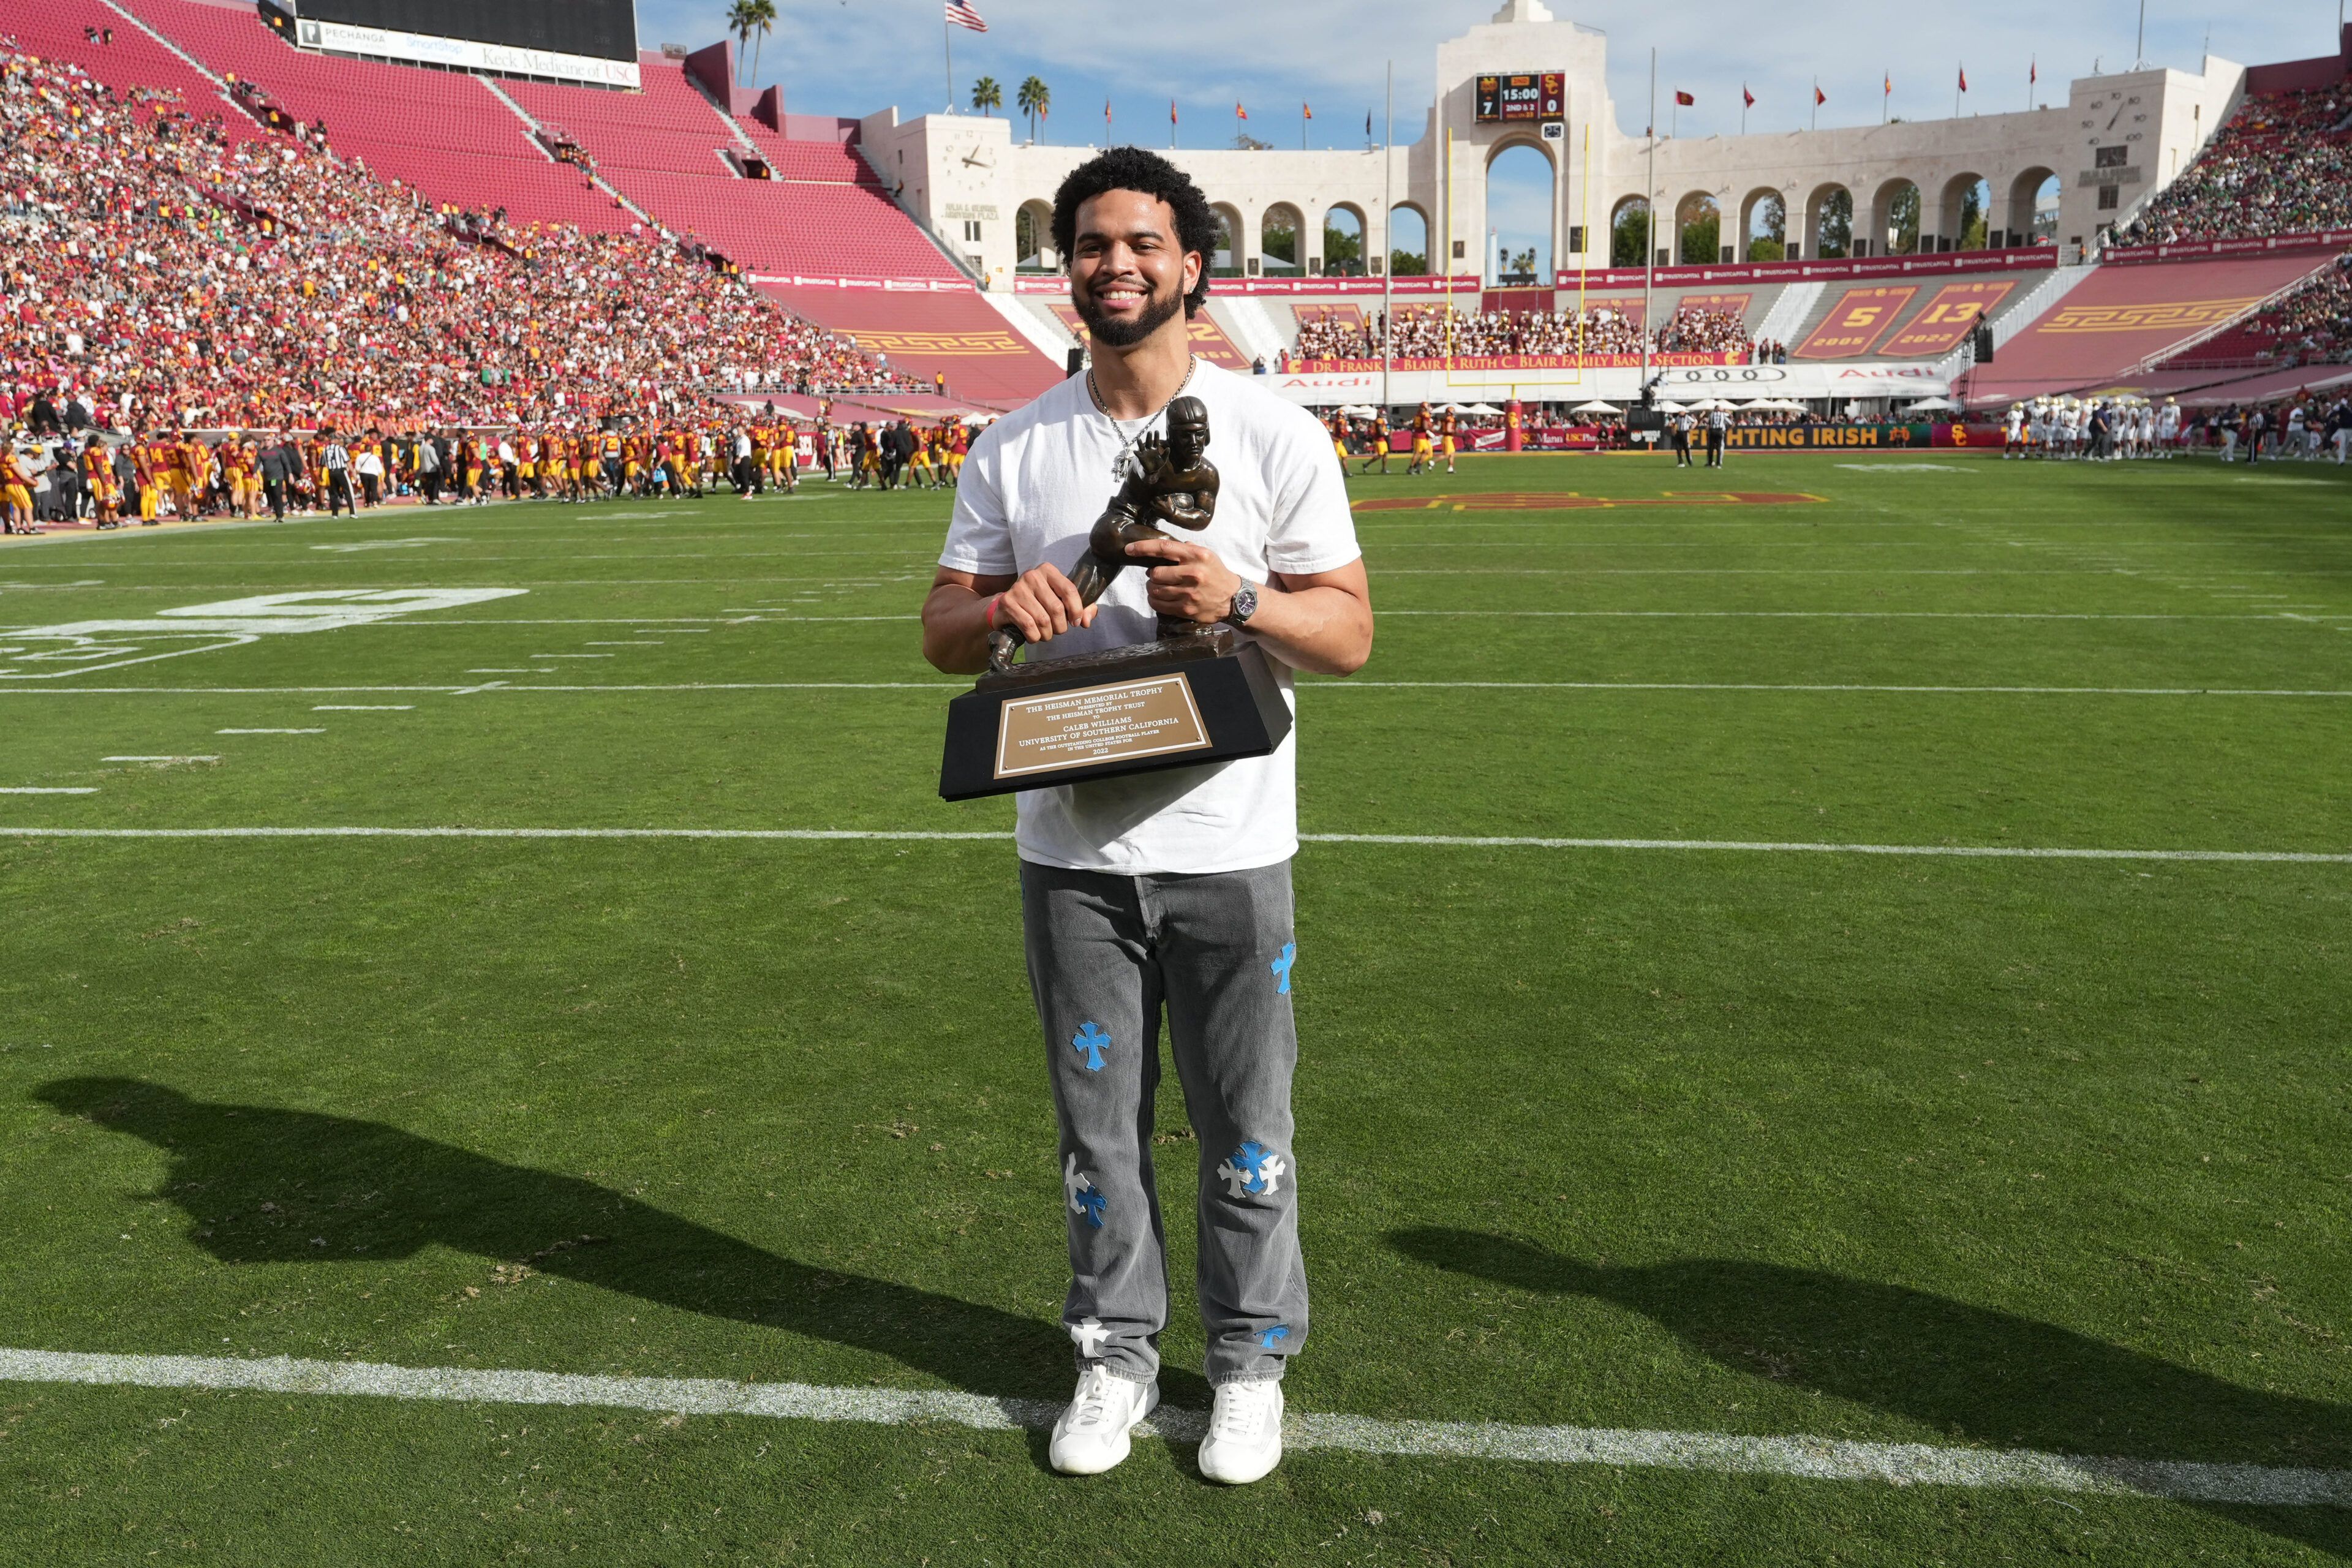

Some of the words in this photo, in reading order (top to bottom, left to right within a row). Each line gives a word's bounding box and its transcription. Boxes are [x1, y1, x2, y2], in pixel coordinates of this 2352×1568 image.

[325, 28, 385, 43] PECHANGA
[406, 37, 464, 54] SmartStop
[483, 48, 519, 68] Keck
[523, 53, 585, 77] Medicine
[587, 62, 602, 78] of
[605, 65, 636, 81] USC
[1503, 88, 1539, 100] 15:00
[1483, 102, 1493, 115] 7
[1547, 99, 1557, 112] 0
[1545, 126, 1561, 138] 25
[1842, 306, 1883, 328] 5
[1921, 302, 1983, 324] 13
[1186, 323, 1223, 341] 2
[1899, 333, 1953, 344] 2022
[1812, 337, 1865, 347] 2005
[1313, 361, 1335, 373] DR.
[1340, 360, 1384, 372] FRANK
[1404, 358, 1442, 371] BLAIR
[1460, 357, 1498, 369] RUTH
[1501, 356, 1515, 368] C.
[1520, 355, 1558, 368] BLAIR
[1562, 355, 1609, 367] FAMILY
[1655, 353, 1714, 366] SECTION
[1838, 366, 1935, 378] Audi
[1282, 377, 1371, 388] Audi
[1689, 428, 1805, 447] FIHTING
[1813, 427, 1877, 445] IRISH
[1044, 699, 1082, 710] HEISMAN
[1084, 692, 1129, 705] MEMORIAL
[1130, 687, 1163, 698] TROPHY
[1061, 709, 1093, 719] HEISMAN
[1095, 706, 1122, 715] TROPHY
[1123, 701, 1145, 710] TRUST
[1019, 734, 1068, 747] UNIVERSITY
[1082, 725, 1127, 737] SOUTHERN
[1128, 717, 1179, 730] CALIFORNIA
[1063, 723, 1088, 732] CALEB
[1091, 716, 1132, 728] WILLIAMS
[1057, 739, 1092, 748] OUTSTANDING
